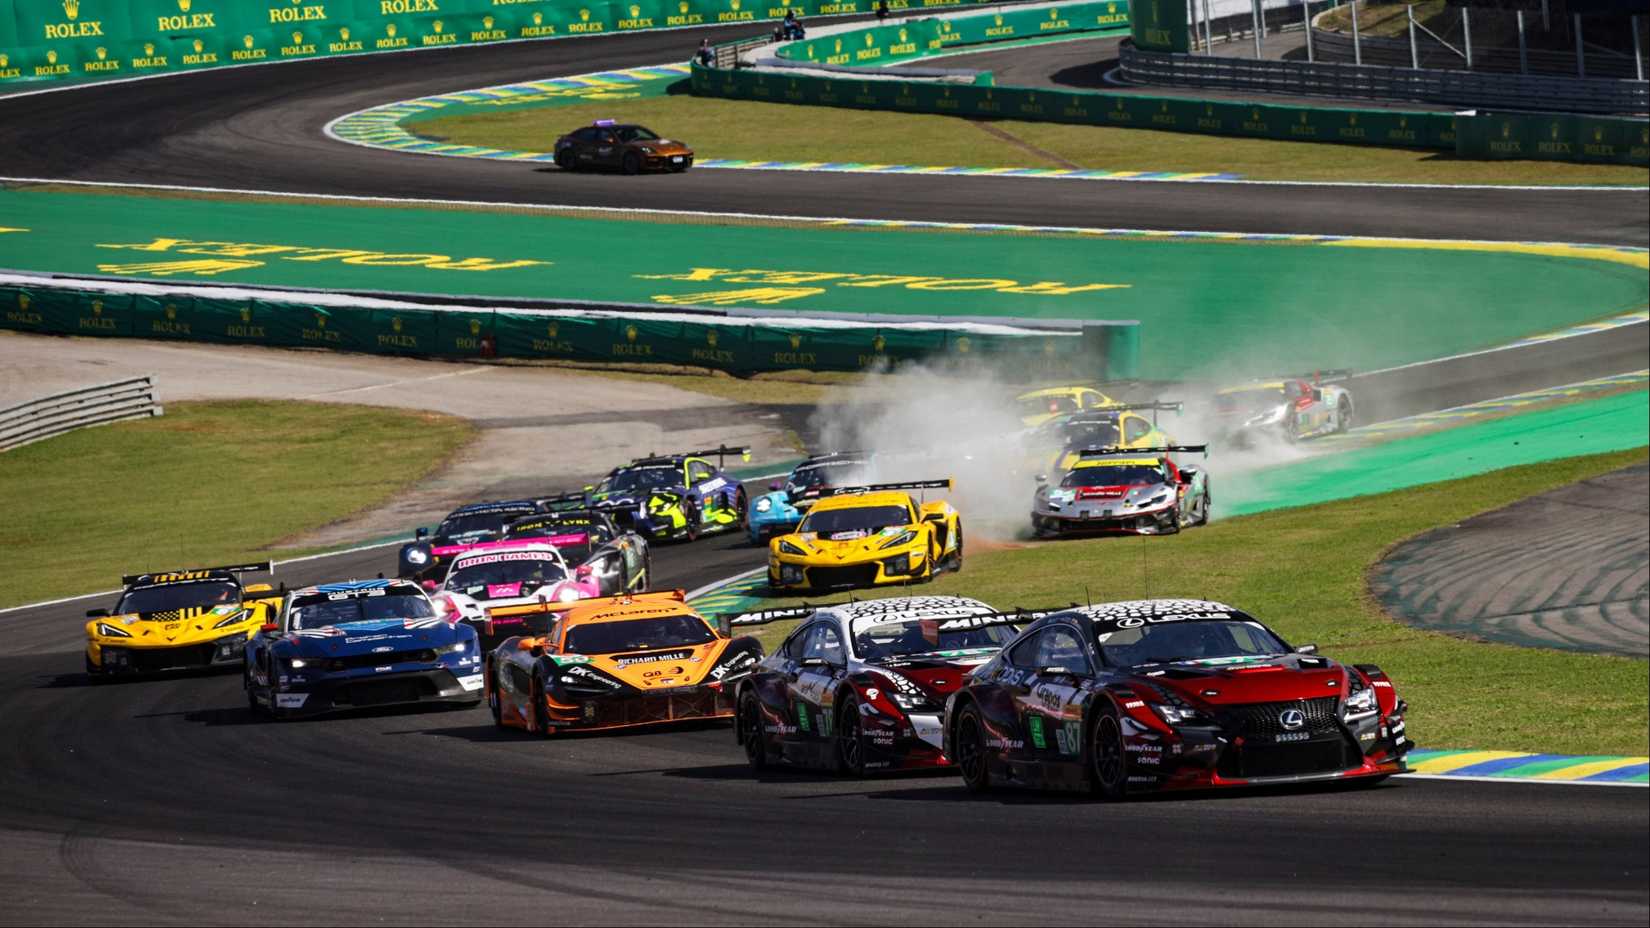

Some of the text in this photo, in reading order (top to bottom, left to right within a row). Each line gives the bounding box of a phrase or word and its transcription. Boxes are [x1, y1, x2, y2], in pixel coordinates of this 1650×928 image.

[381, 0, 439, 15] ROLEX
[270, 6, 327, 24] ROLEX
[667, 14, 703, 25] ROLEX
[719, 10, 753, 22] ROLEX
[1097, 14, 1128, 24] ROLEX
[158, 13, 216, 31] ROLEX
[568, 22, 603, 33] ROLEX
[618, 17, 652, 29] ROLEX
[45, 21, 104, 39] ROLEX
[471, 30, 507, 41] ROLEX
[521, 25, 556, 37] ROLEX
[377, 38, 409, 49] ROLEX
[423, 33, 456, 45] ROLEX
[282, 45, 315, 57] ROLEX
[330, 41, 362, 53] ROLEX
[183, 53, 217, 65] ROLEX
[233, 49, 267, 60] ROLEX
[85, 60, 119, 72] ROLEX
[133, 57, 167, 69] ROLEX
[36, 64, 70, 76] ROLEX
[562, 519, 591, 527] LYNX
[1147, 613, 1231, 623] LEXUS
[617, 652, 685, 665] RICHARD MILLE
[568, 666, 591, 677] DK
[1064, 721, 1081, 753] 87
